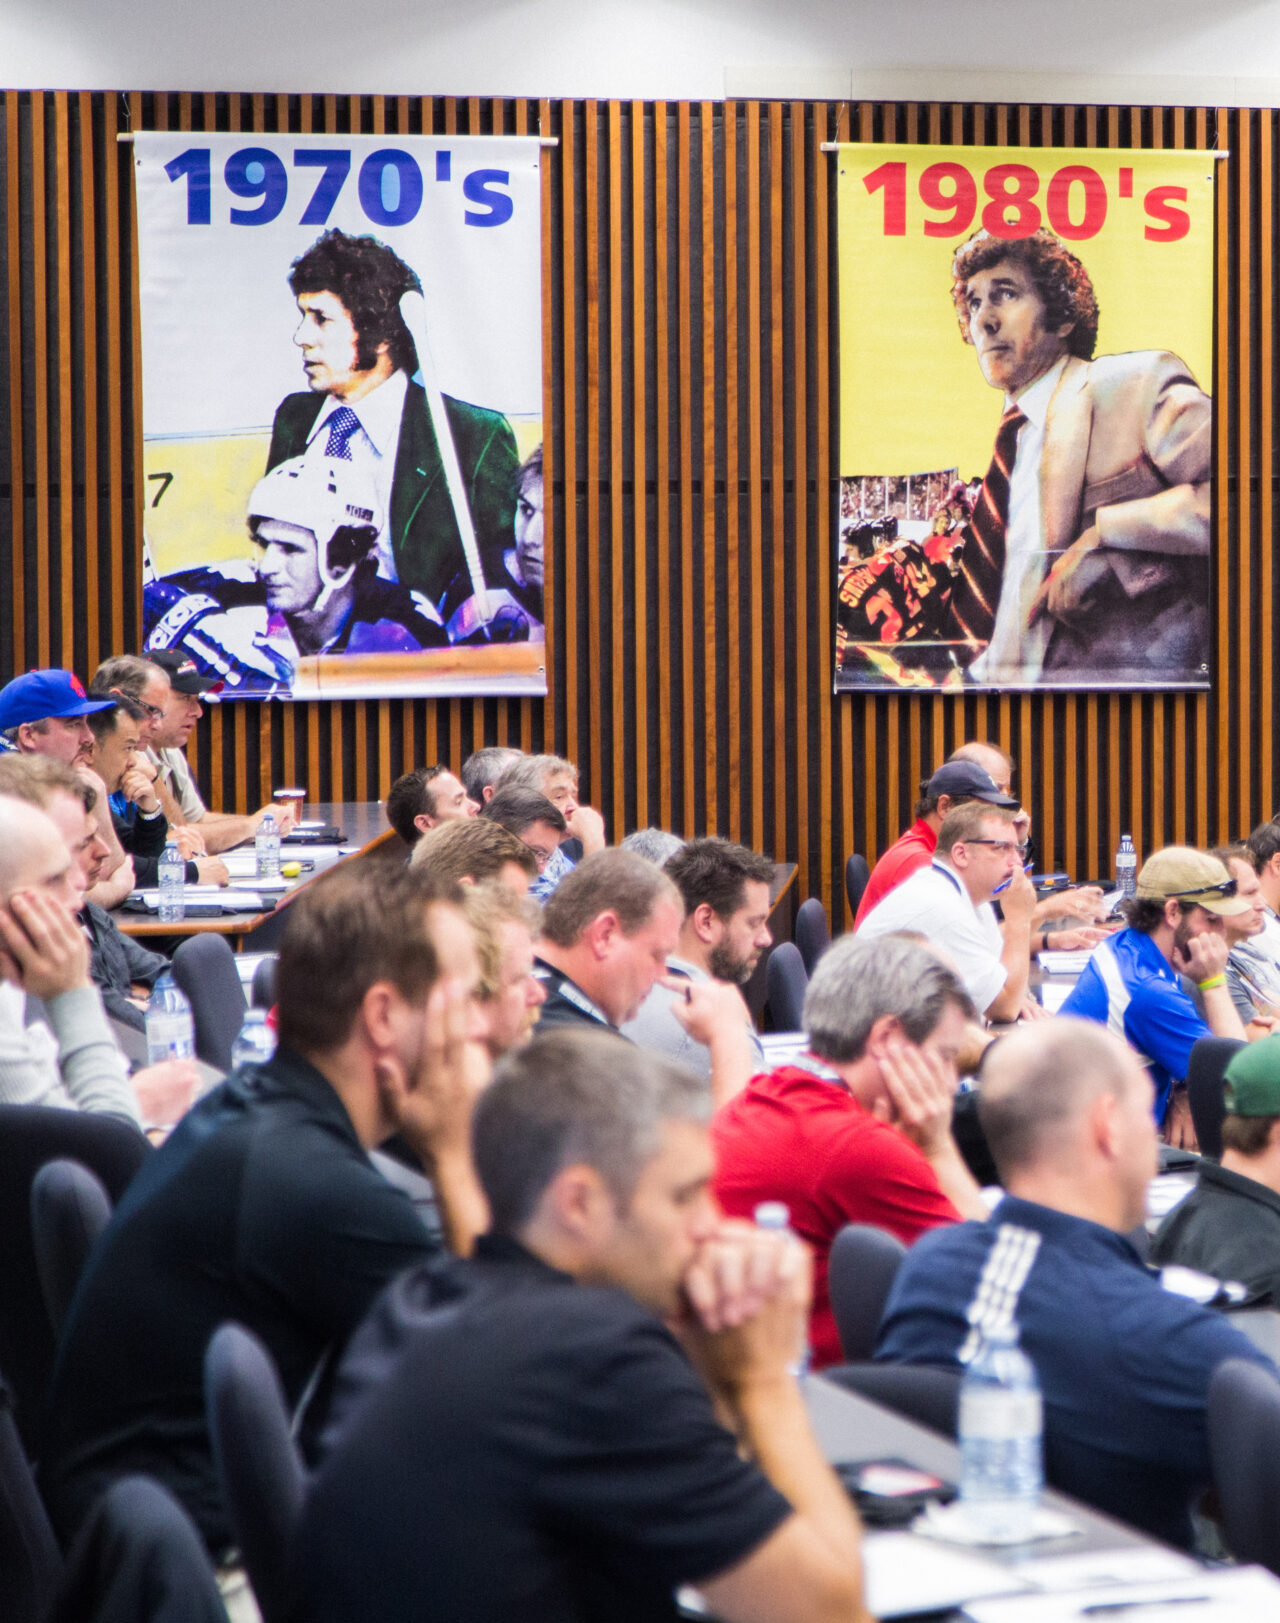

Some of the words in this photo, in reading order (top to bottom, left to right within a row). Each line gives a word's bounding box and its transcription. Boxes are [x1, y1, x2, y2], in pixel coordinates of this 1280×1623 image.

[164, 147, 514, 227] 1970's
[863, 162, 1190, 242] 1980's
[147, 472, 173, 508] 7
